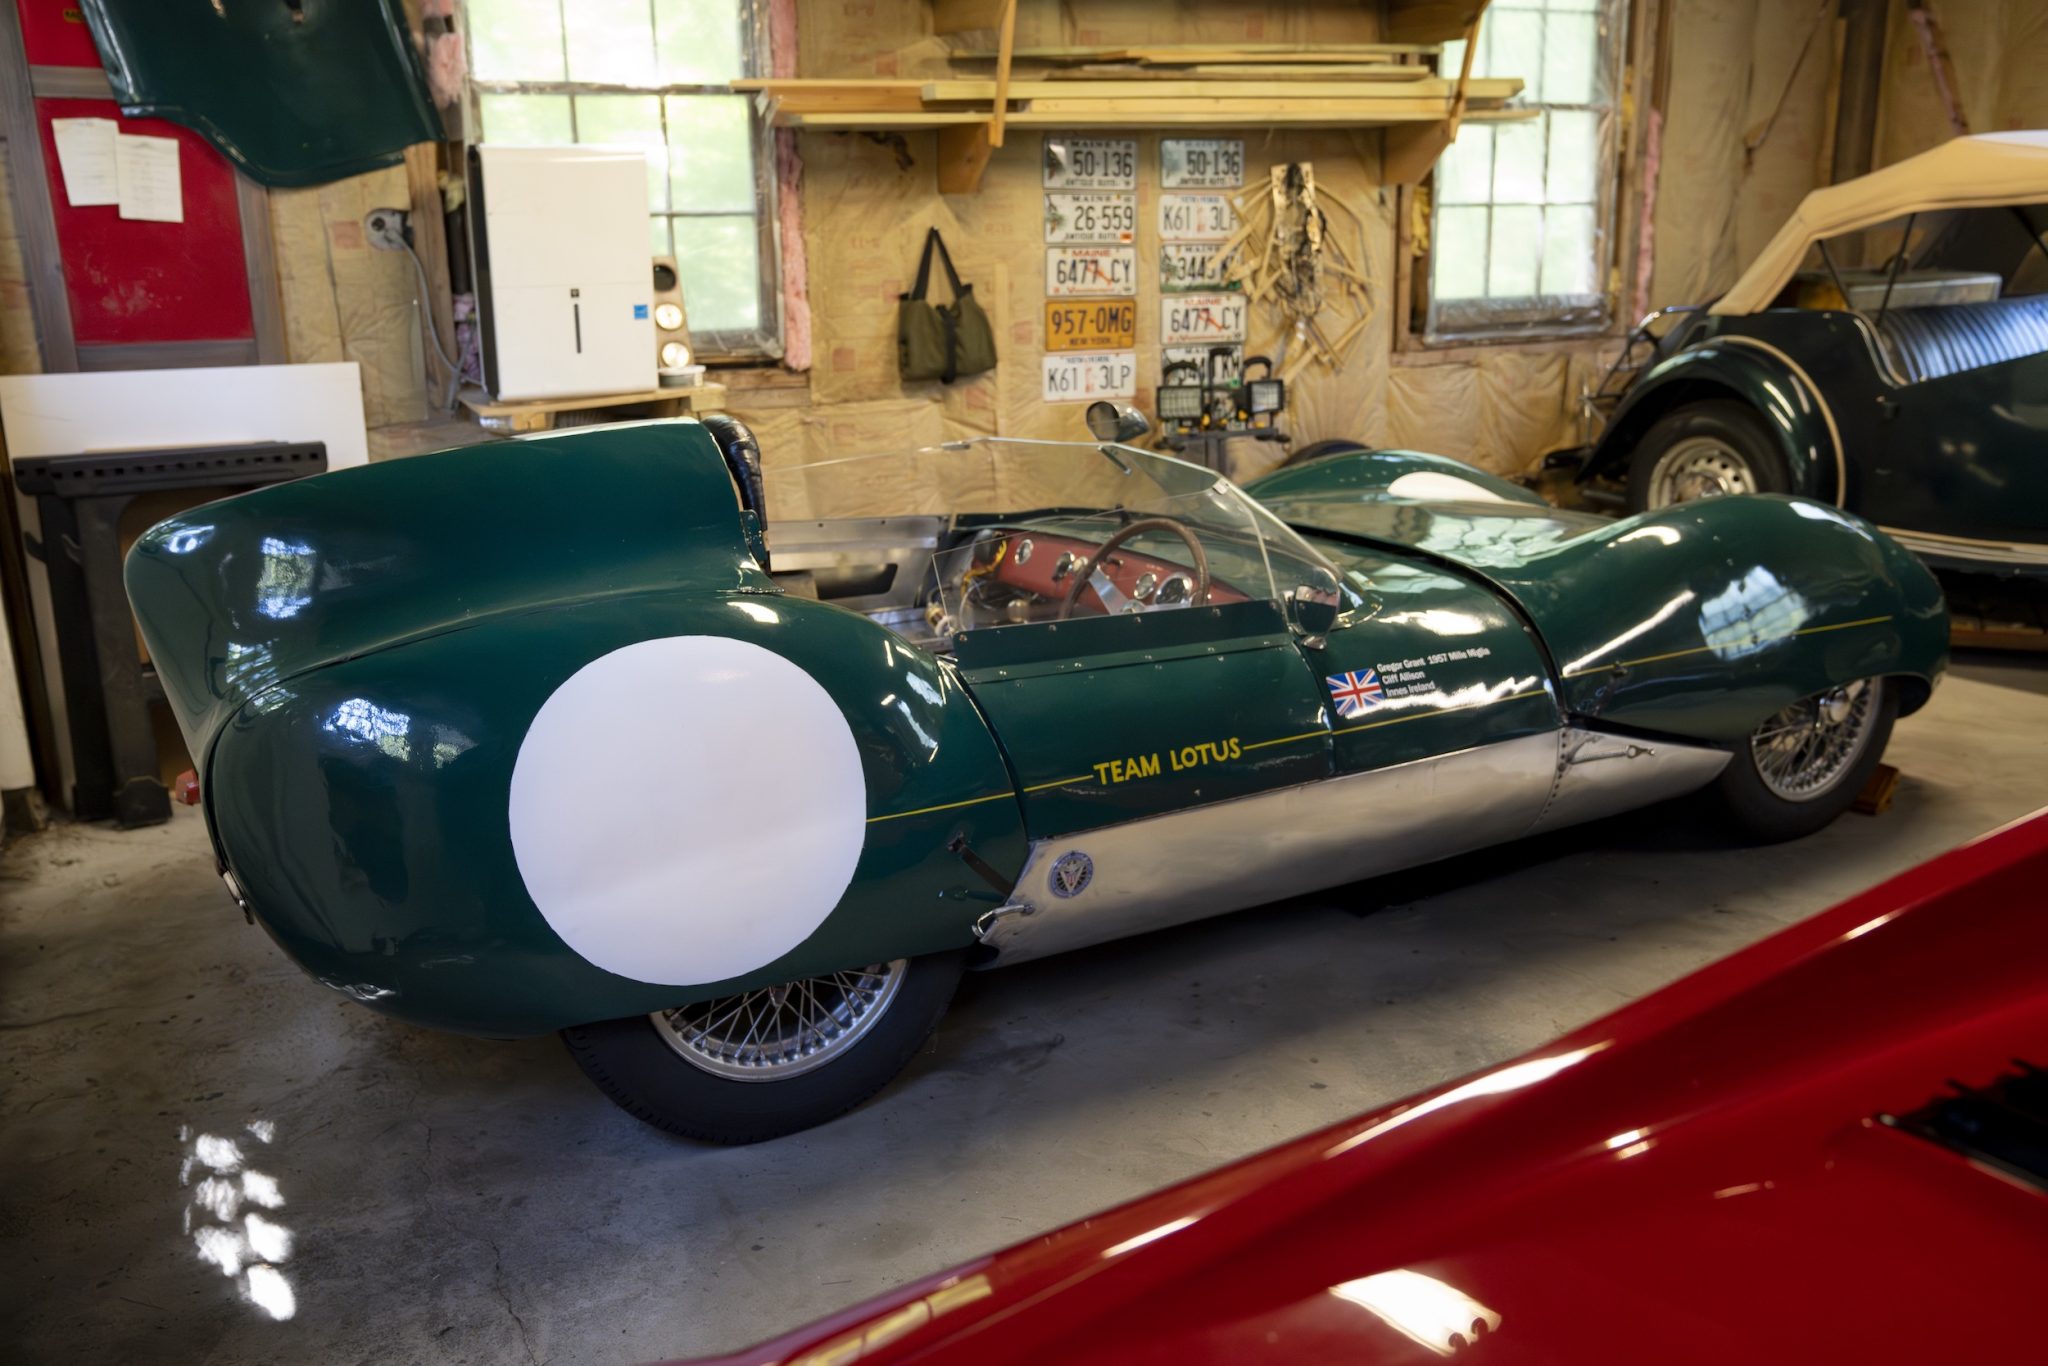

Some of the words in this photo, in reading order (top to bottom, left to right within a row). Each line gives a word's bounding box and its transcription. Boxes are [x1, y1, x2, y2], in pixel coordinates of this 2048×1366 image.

[1072, 249, 1111, 257] MAINE
[1057, 258, 1098, 284] 6477
[1111, 258, 1131, 284] CY
[1171, 308, 1210, 333] 6477
[1222, 306, 1241, 330] CY
[1048, 367, 1078, 392] K61
[1098, 364, 1131, 390] 3LP
[1376, 662, 1403, 673] Gregor
[1403, 657, 1426, 669] Grant
[1427, 653, 1448, 665] 1957
[1382, 673, 1398, 685] Cliff
[1399, 671, 1426, 682] Allison
[1386, 686, 1408, 697] Innes
[1408, 680, 1436, 693] Ireland
[1093, 752, 1161, 785] TEAM
[1169, 737, 1241, 771] LOTUS
